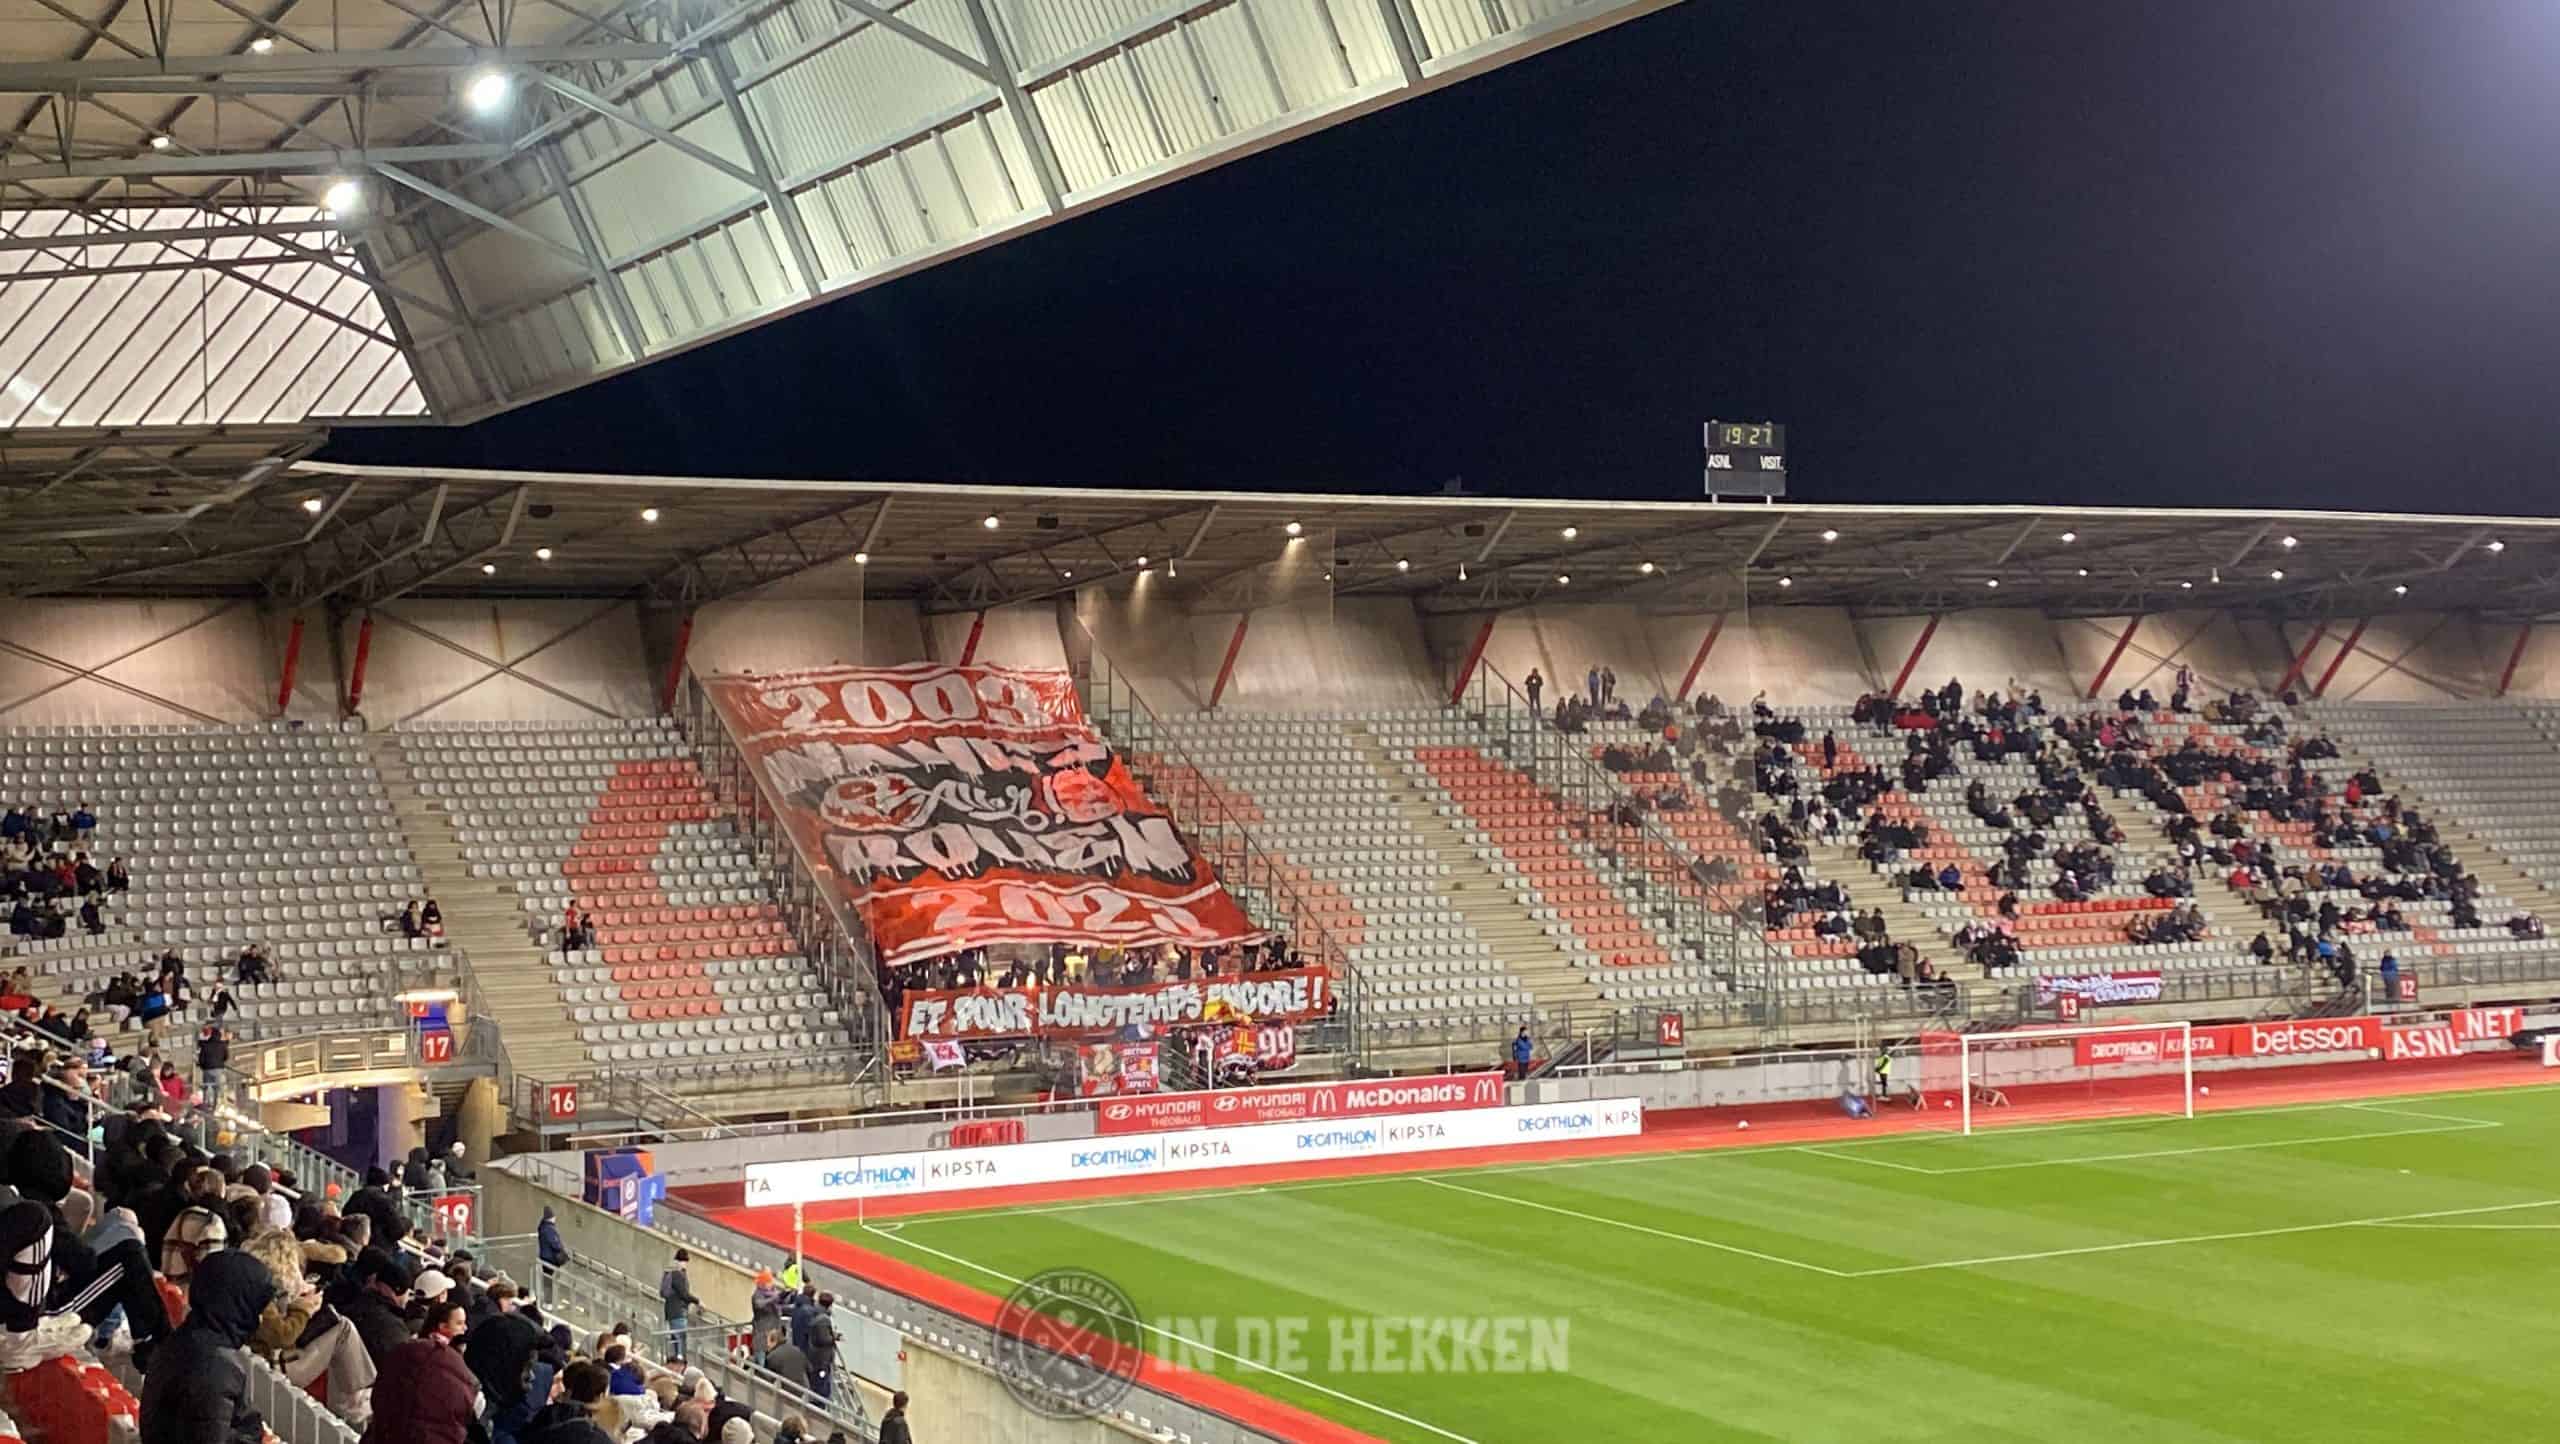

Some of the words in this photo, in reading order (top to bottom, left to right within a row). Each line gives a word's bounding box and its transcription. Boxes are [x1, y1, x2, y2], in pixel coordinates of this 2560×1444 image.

[824, 815, 1190, 884] ROUEN
[2401, 980, 2416, 995] 12
[908, 1000, 947, 1036] ET
[954, 992, 1032, 1032] POUR
[1039, 984, 1200, 1027] LONGTEMPS
[2061, 998, 2077, 1016] 13
[1258, 1026, 1294, 1059] 99
[1662, 1021, 1679, 1040] 14
[2253, 1025, 2363, 1053] betsson
[2392, 1029, 2464, 1057] ASNL
[426, 1037, 449, 1058] 17
[552, 1092, 575, 1112] 16
[1242, 1093, 1306, 1109] HYUNDAI
[1347, 1083, 1466, 1108] McDonald's
[1136, 1101, 1200, 1117] HYUNDAI
[1518, 1113, 1592, 1132] DECATHLON
[1297, 1129, 1376, 1149] DECATHLON
[1389, 1124, 1445, 1141] KIPSTA
[1071, 1147, 1157, 1168] DECATHLON
[1170, 1142, 1231, 1159] KIPSTA
[823, 1166, 915, 1187] DECATHLON
[931, 1160, 996, 1178] KIPSTA
